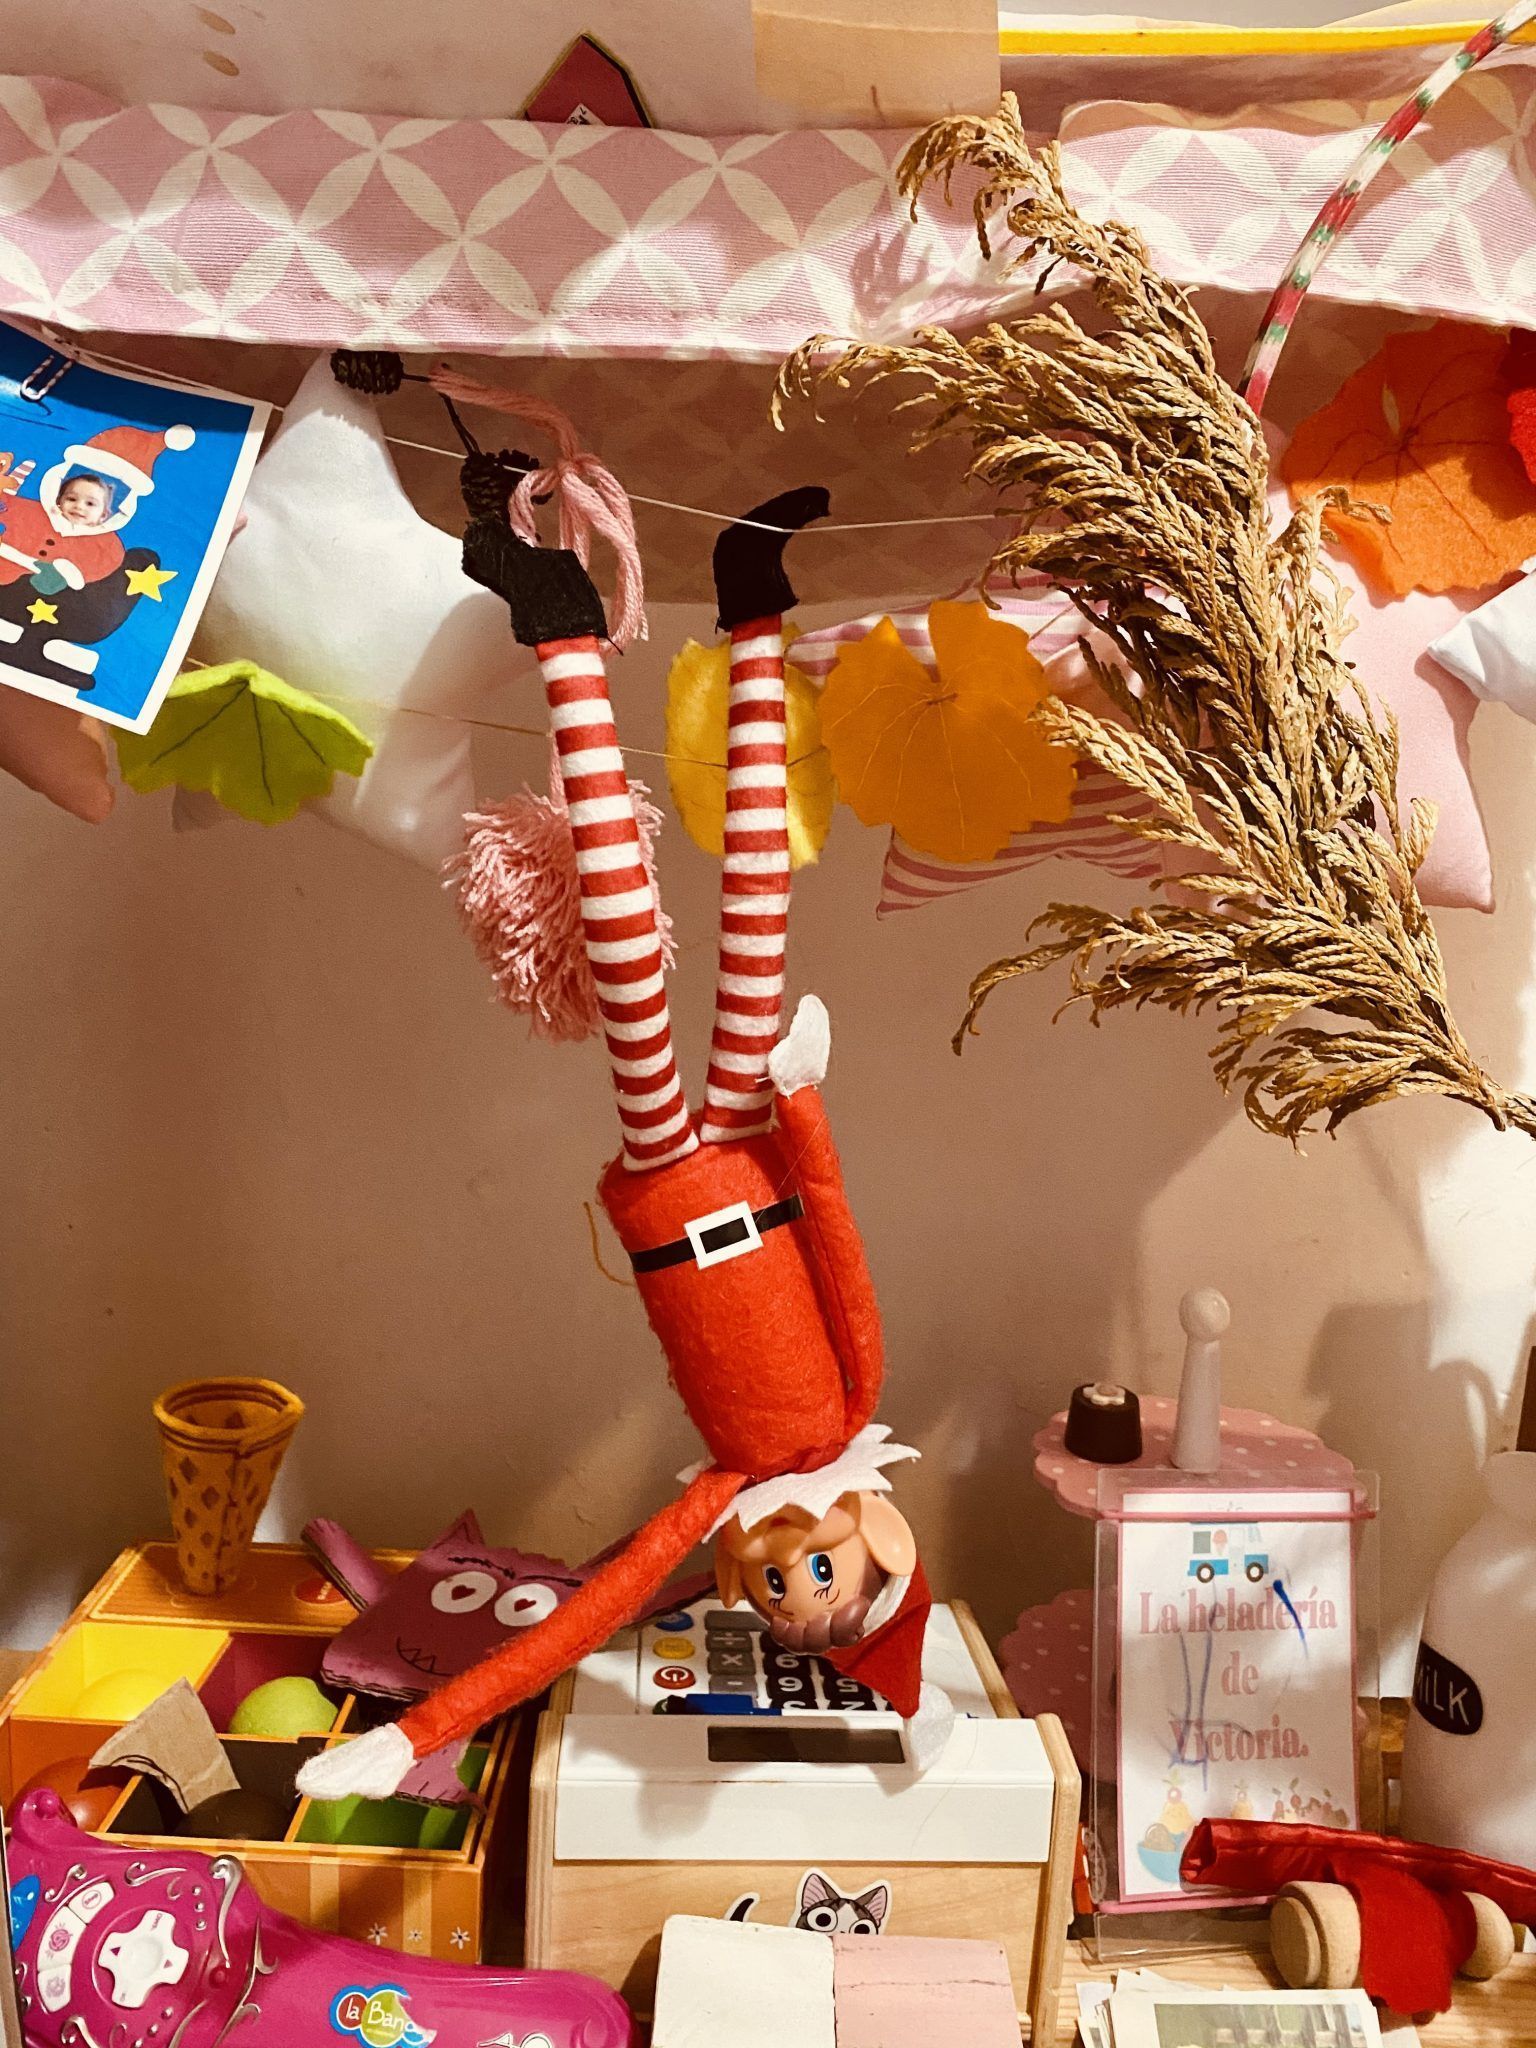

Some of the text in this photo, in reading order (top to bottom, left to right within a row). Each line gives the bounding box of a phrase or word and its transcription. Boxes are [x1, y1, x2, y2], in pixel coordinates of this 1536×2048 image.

[1140, 1585, 1338, 1634] La heladería
[1221, 1650, 1260, 1696] de
[1168, 1713, 1309, 1762] Victoria.
[345, 1997, 360, 2021] la
